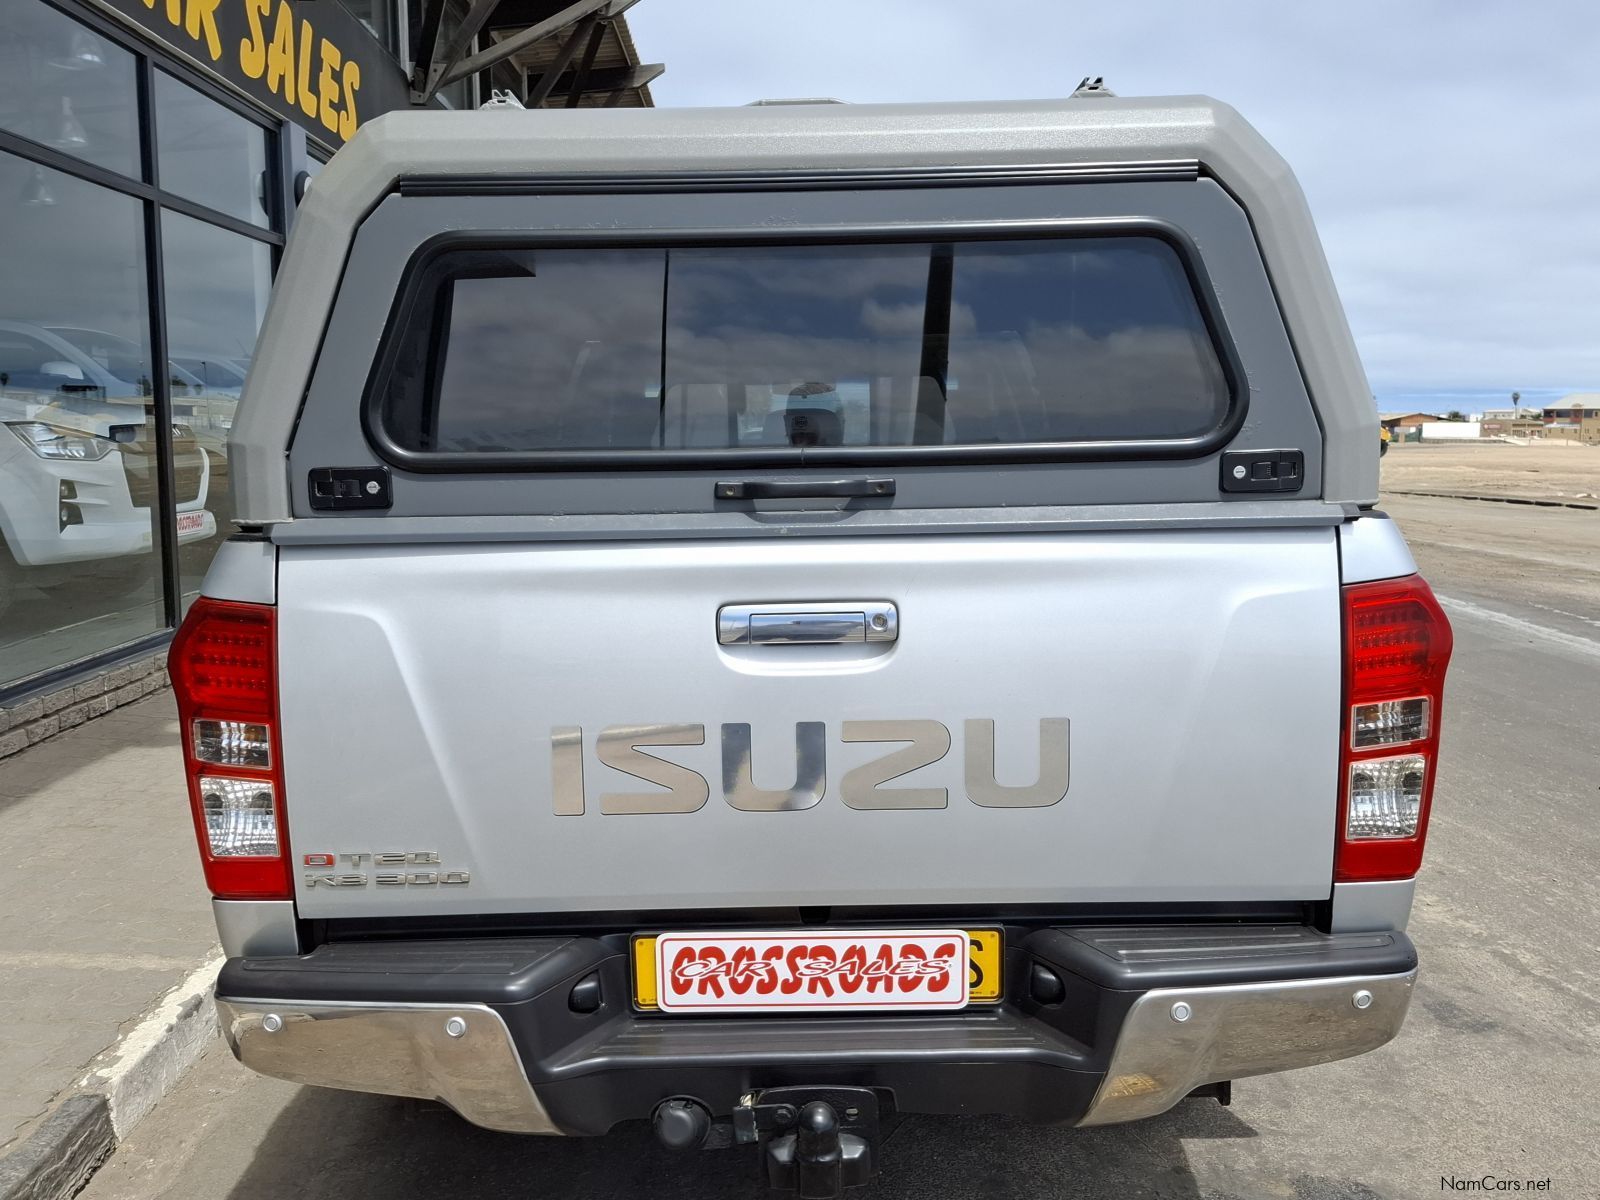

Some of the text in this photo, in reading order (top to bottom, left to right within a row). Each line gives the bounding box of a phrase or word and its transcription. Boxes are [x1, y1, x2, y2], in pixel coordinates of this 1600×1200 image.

[240, 0, 360, 142] SALES
[551, 717, 1070, 816] ISUZU
[376, 871, 470, 886] 300
[671, 943, 956, 999] CROSSROADS
[676, 958, 951, 978] CAR SALES
